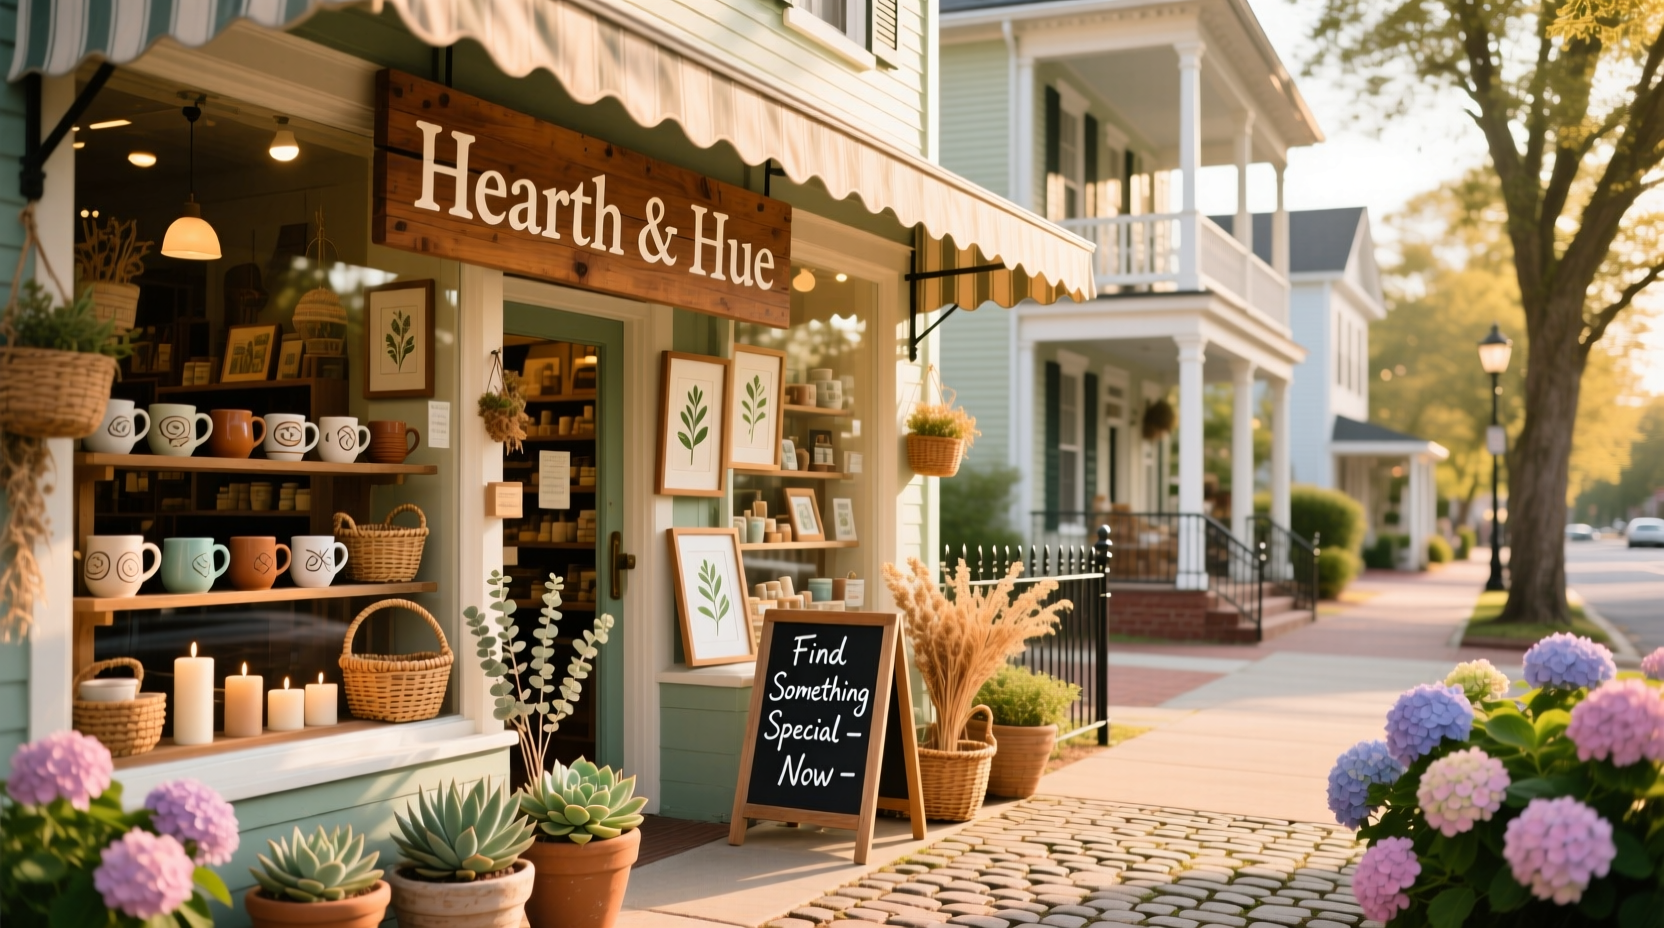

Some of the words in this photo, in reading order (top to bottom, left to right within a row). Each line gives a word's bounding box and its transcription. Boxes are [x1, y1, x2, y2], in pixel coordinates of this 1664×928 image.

[414, 120, 624, 256] Hearth
[638, 196, 678, 266] &
[689, 204, 775, 291] Hue
[793, 634, 848, 666] Find
[769, 671, 869, 717] Something
[764, 709, 841, 751] Special
[777, 753, 834, 787] Now
